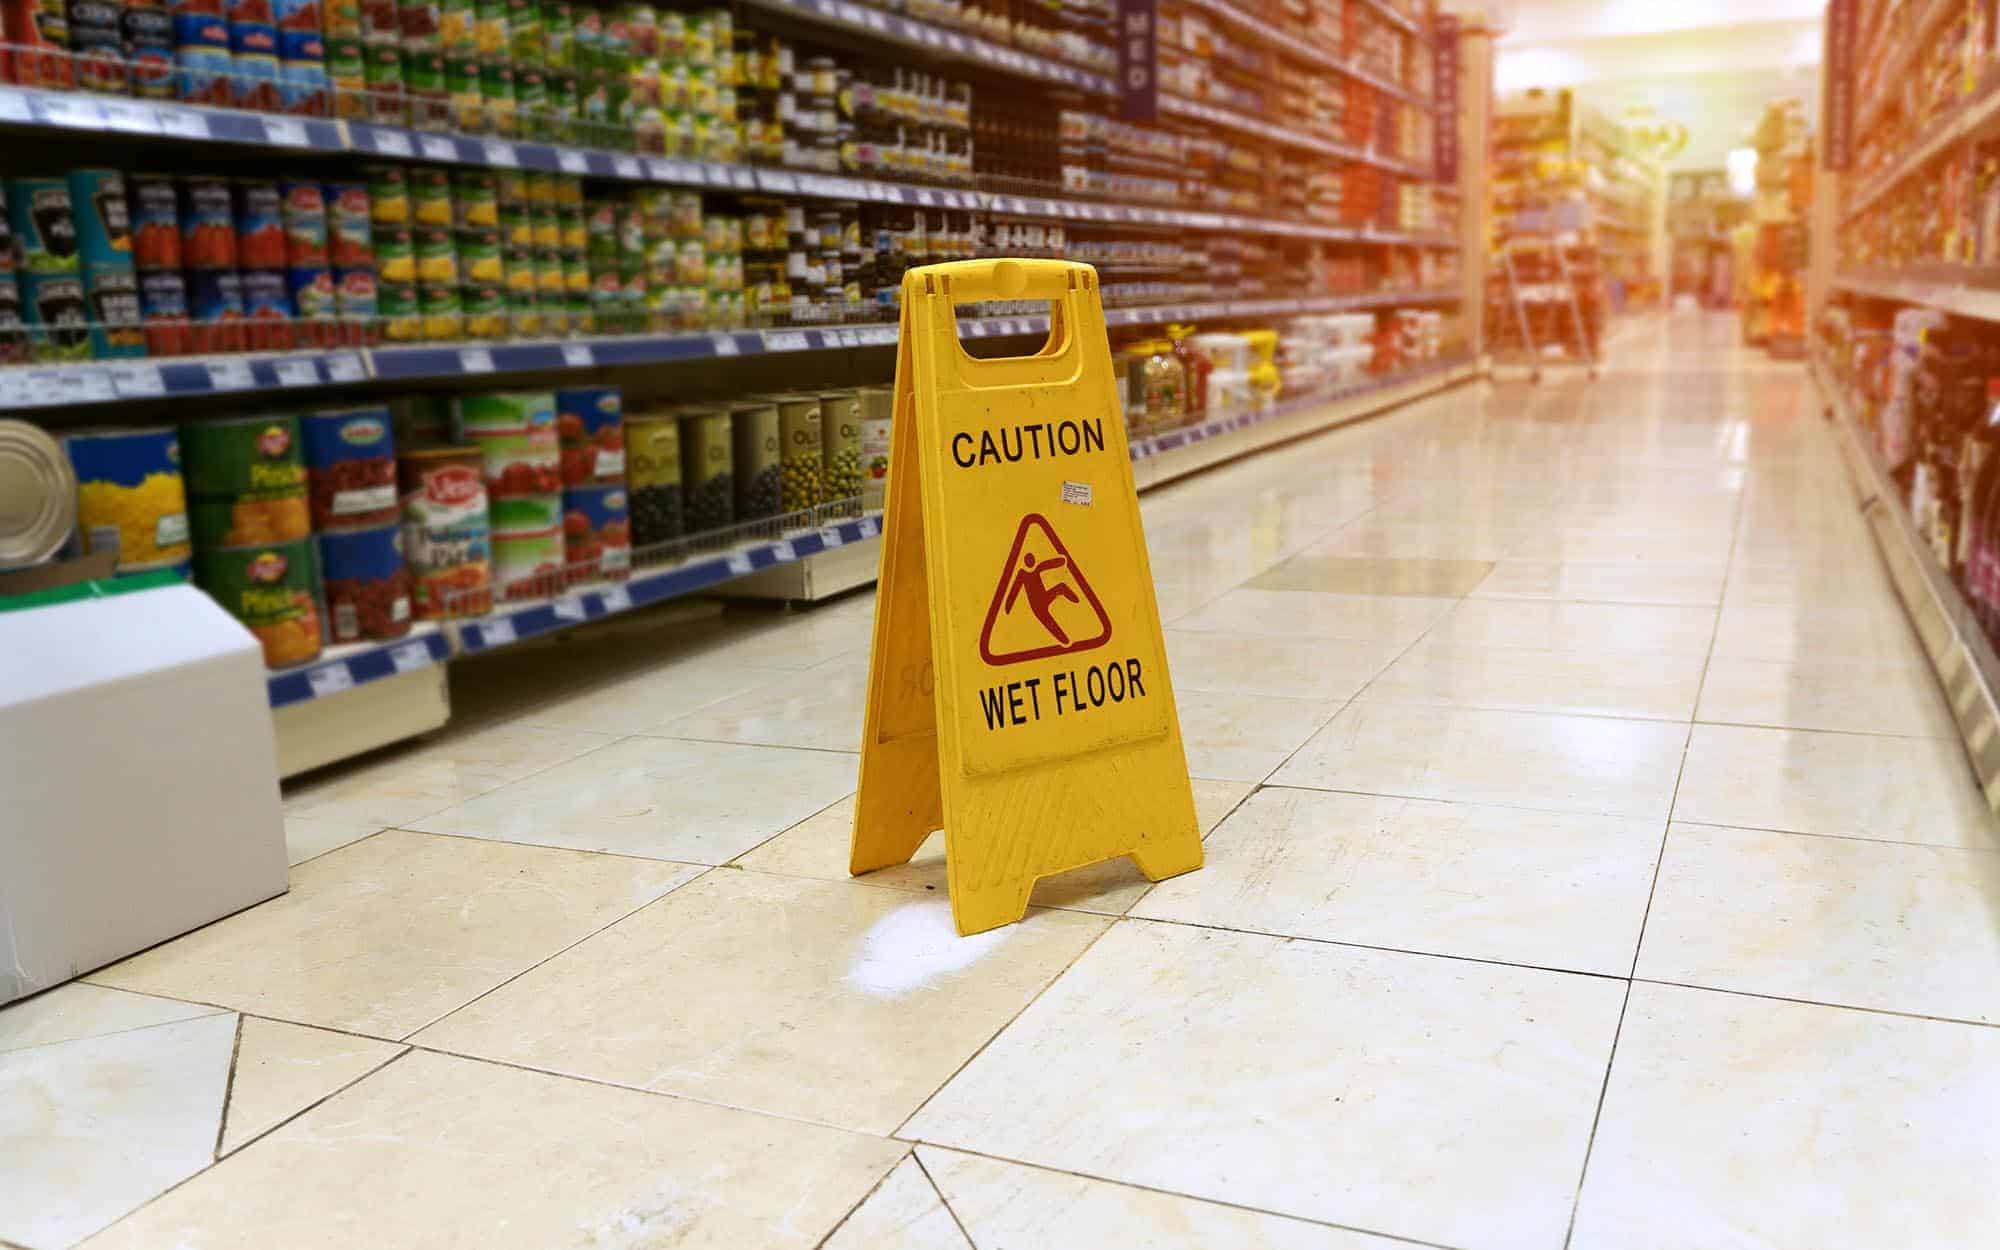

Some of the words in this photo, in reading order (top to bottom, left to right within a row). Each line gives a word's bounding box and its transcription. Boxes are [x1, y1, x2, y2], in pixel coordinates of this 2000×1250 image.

[952, 418, 1105, 468] CAUTION
[979, 678, 1041, 731] WET
[1053, 658, 1146, 715] FLOOR
